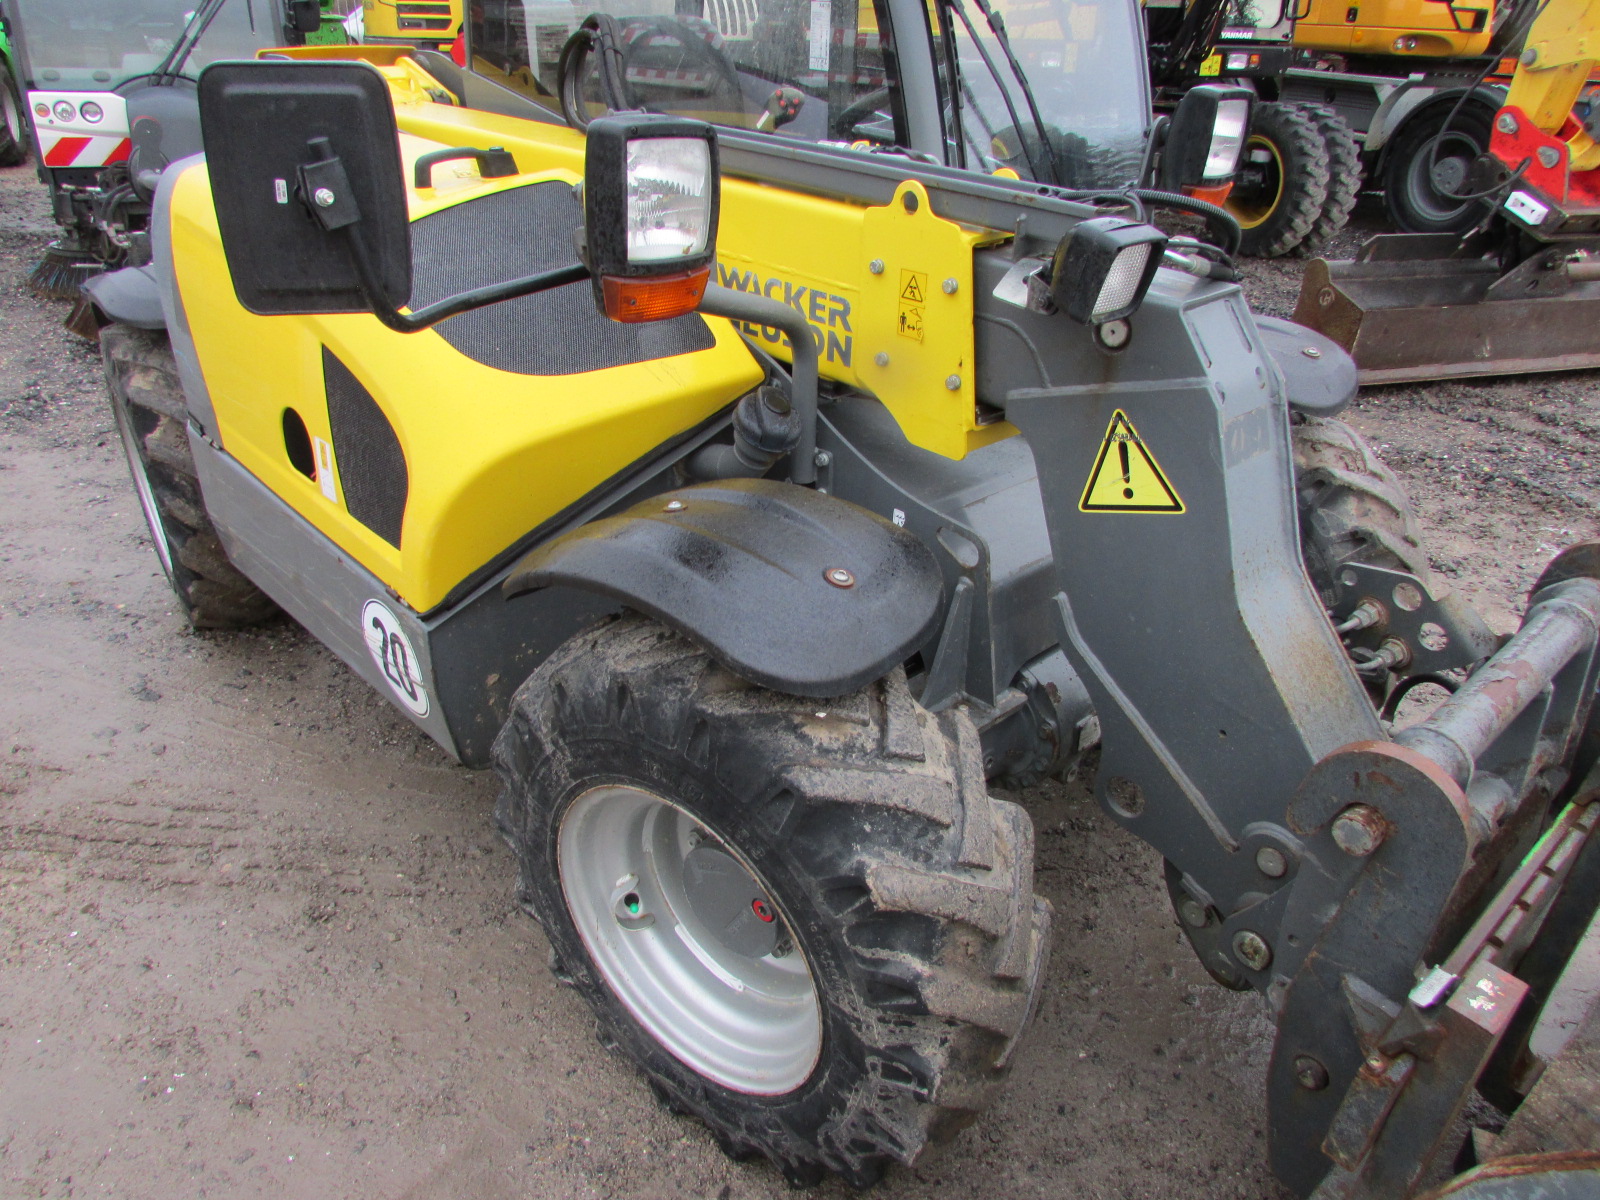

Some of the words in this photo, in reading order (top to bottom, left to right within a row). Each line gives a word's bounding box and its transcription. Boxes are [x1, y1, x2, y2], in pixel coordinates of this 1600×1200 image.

[1221, 31, 1253, 39] YANMAR
[718, 263, 853, 333] WACKER
[731, 318, 852, 368] EUON
[372, 616, 418, 702] 20
